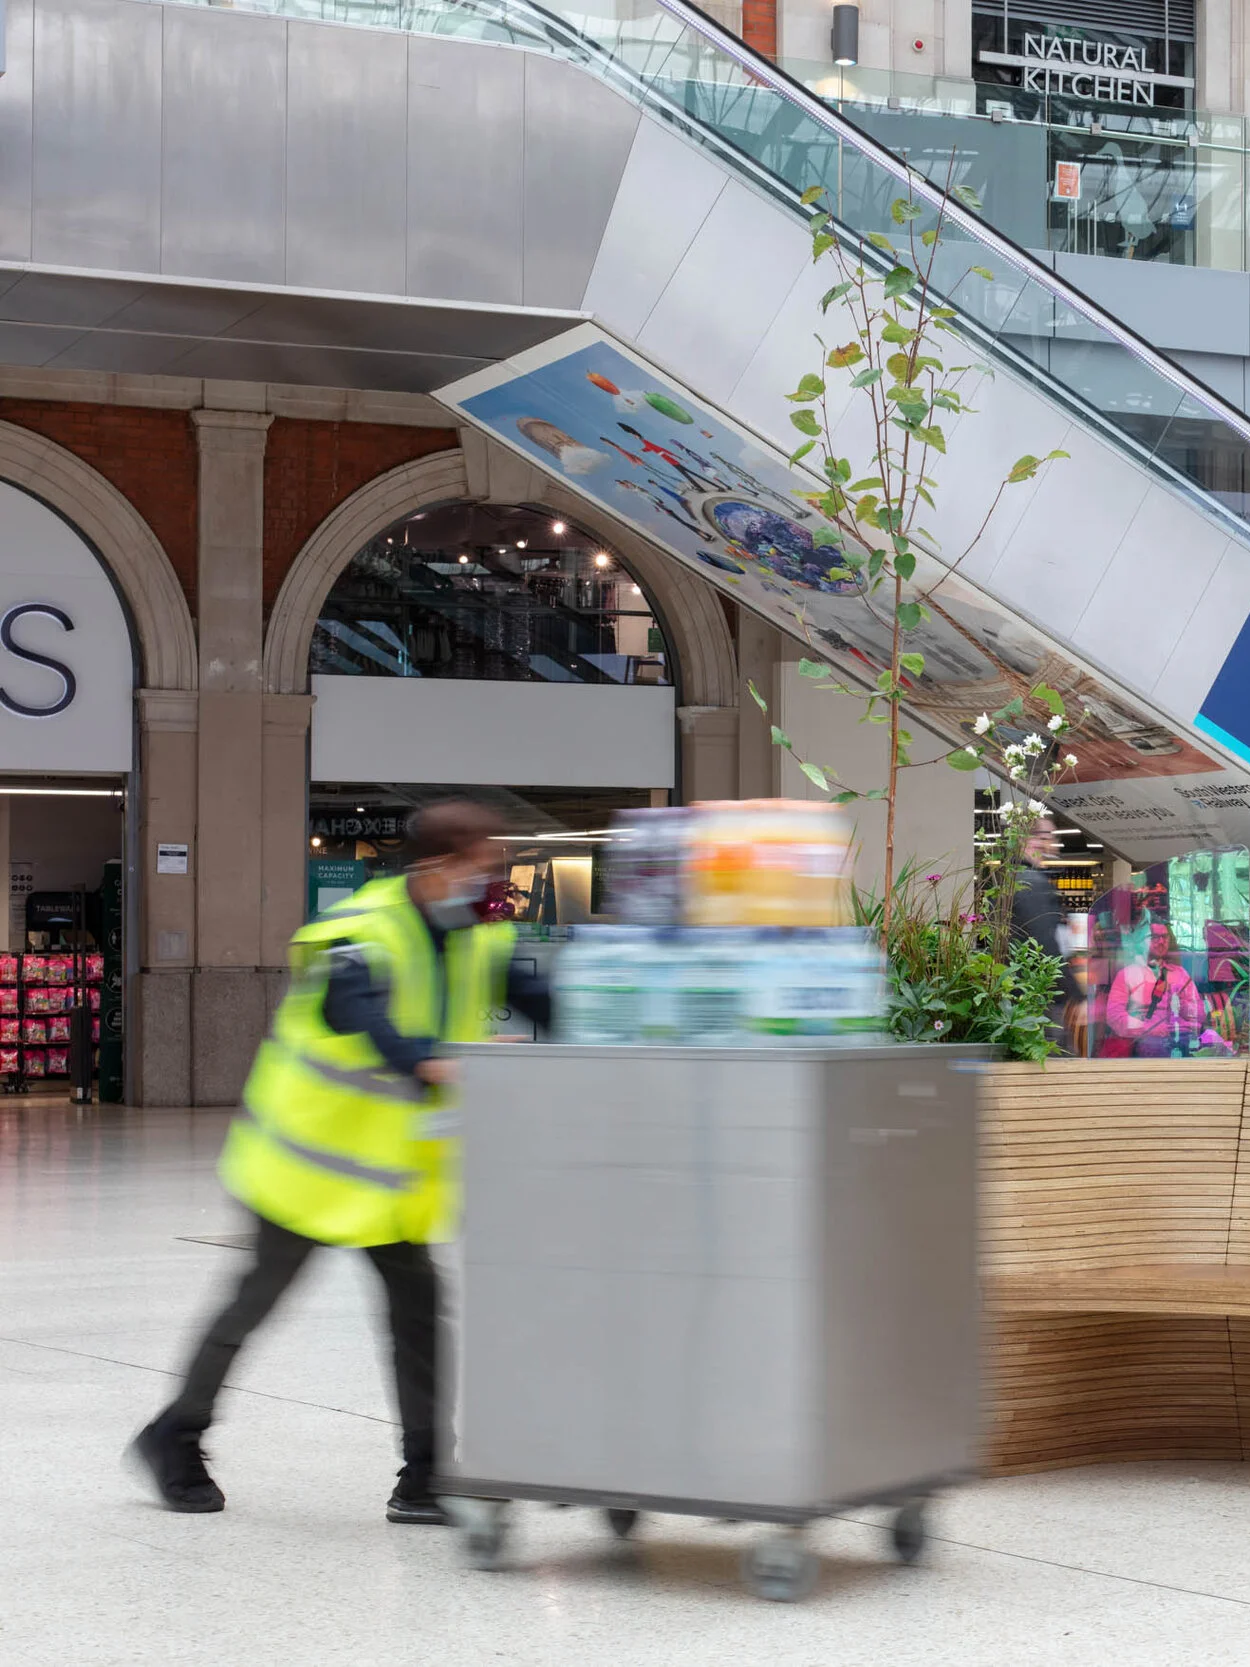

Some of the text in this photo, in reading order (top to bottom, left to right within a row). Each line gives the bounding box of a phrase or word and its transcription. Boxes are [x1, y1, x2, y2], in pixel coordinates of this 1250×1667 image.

[1024, 32, 1155, 73] NATURAL
[1024, 66, 1155, 108] KITCHEN
[0, 603, 76, 717] S
[1050, 793, 1125, 809] Great days
[1173, 785, 1210, 800] South
[1203, 797, 1250, 810] Railway
[1074, 805, 1176, 824] never leave you
